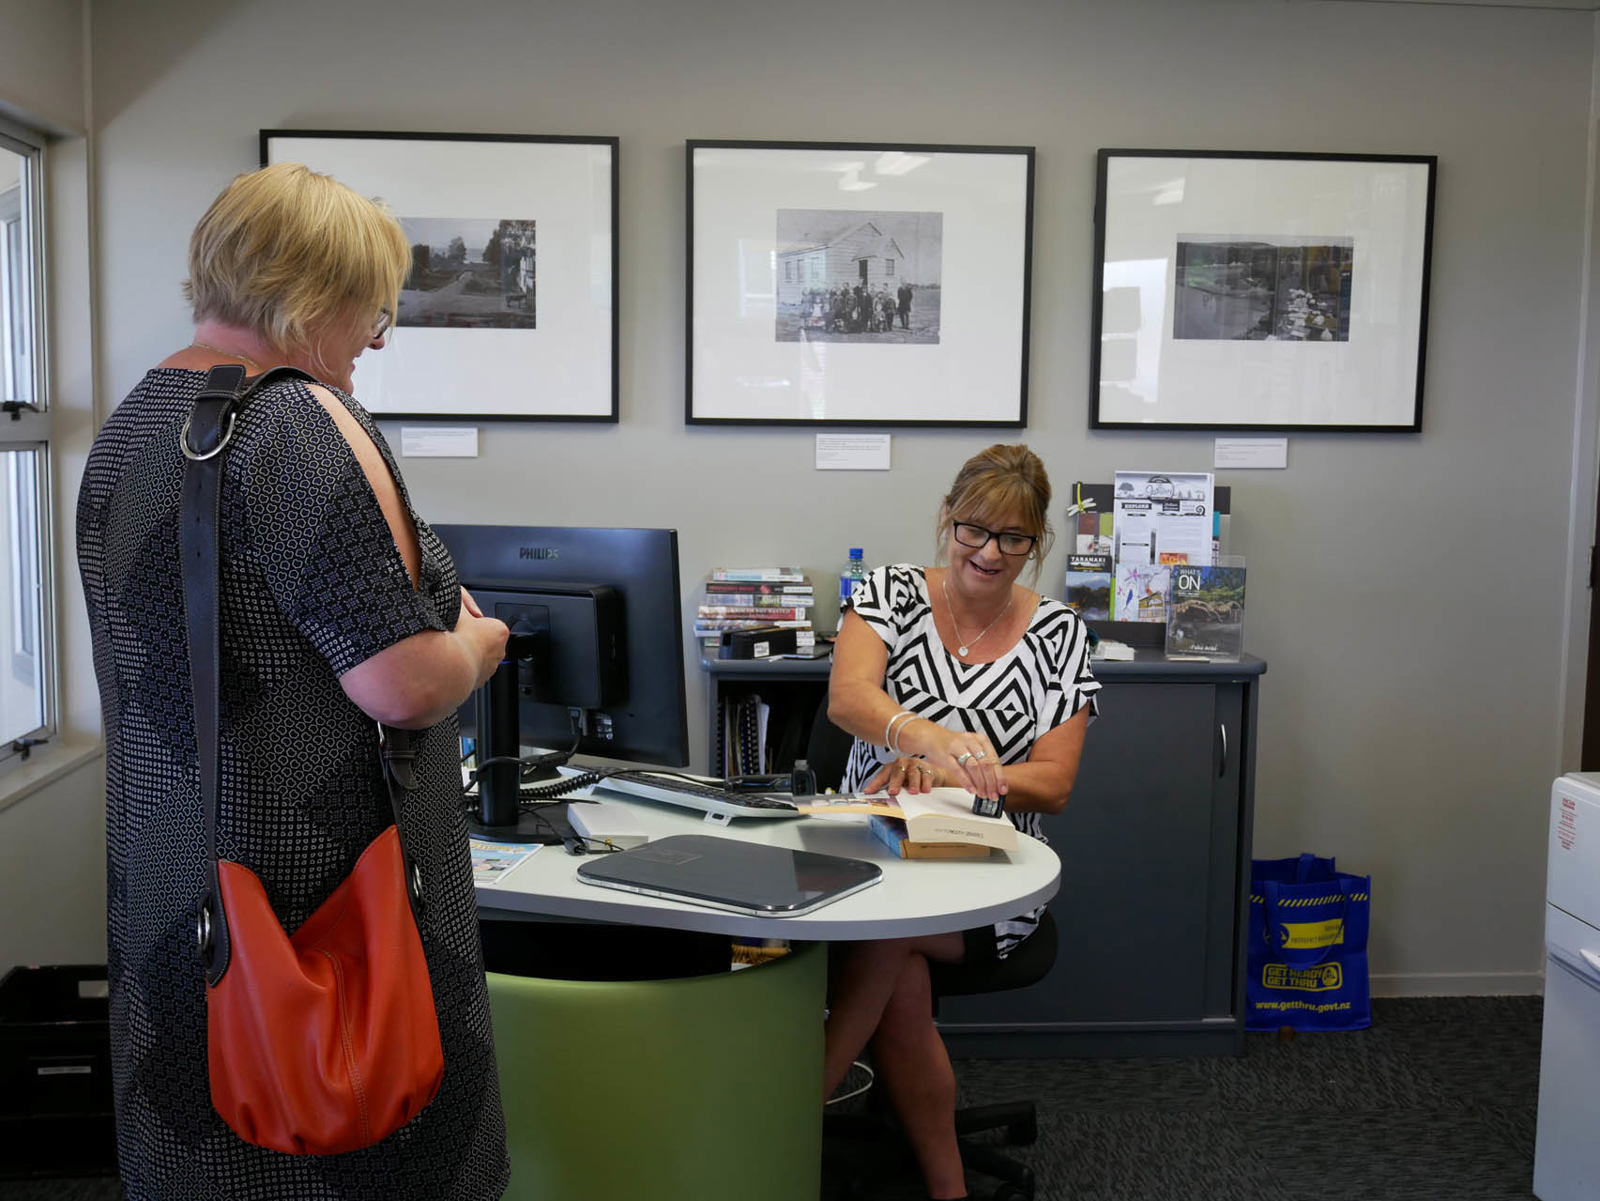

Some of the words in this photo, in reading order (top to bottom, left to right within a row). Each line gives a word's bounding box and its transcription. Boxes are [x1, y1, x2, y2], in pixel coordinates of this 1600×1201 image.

[519, 547, 560, 560] PHILIPS
[1178, 575, 1201, 590] ON
[1268, 967, 1287, 976] GET
[1268, 976, 1287, 985] GET
[1289, 977, 1318, 988] THRU
[1256, 1001, 1351, 1013] www.getthru.govt.nz
